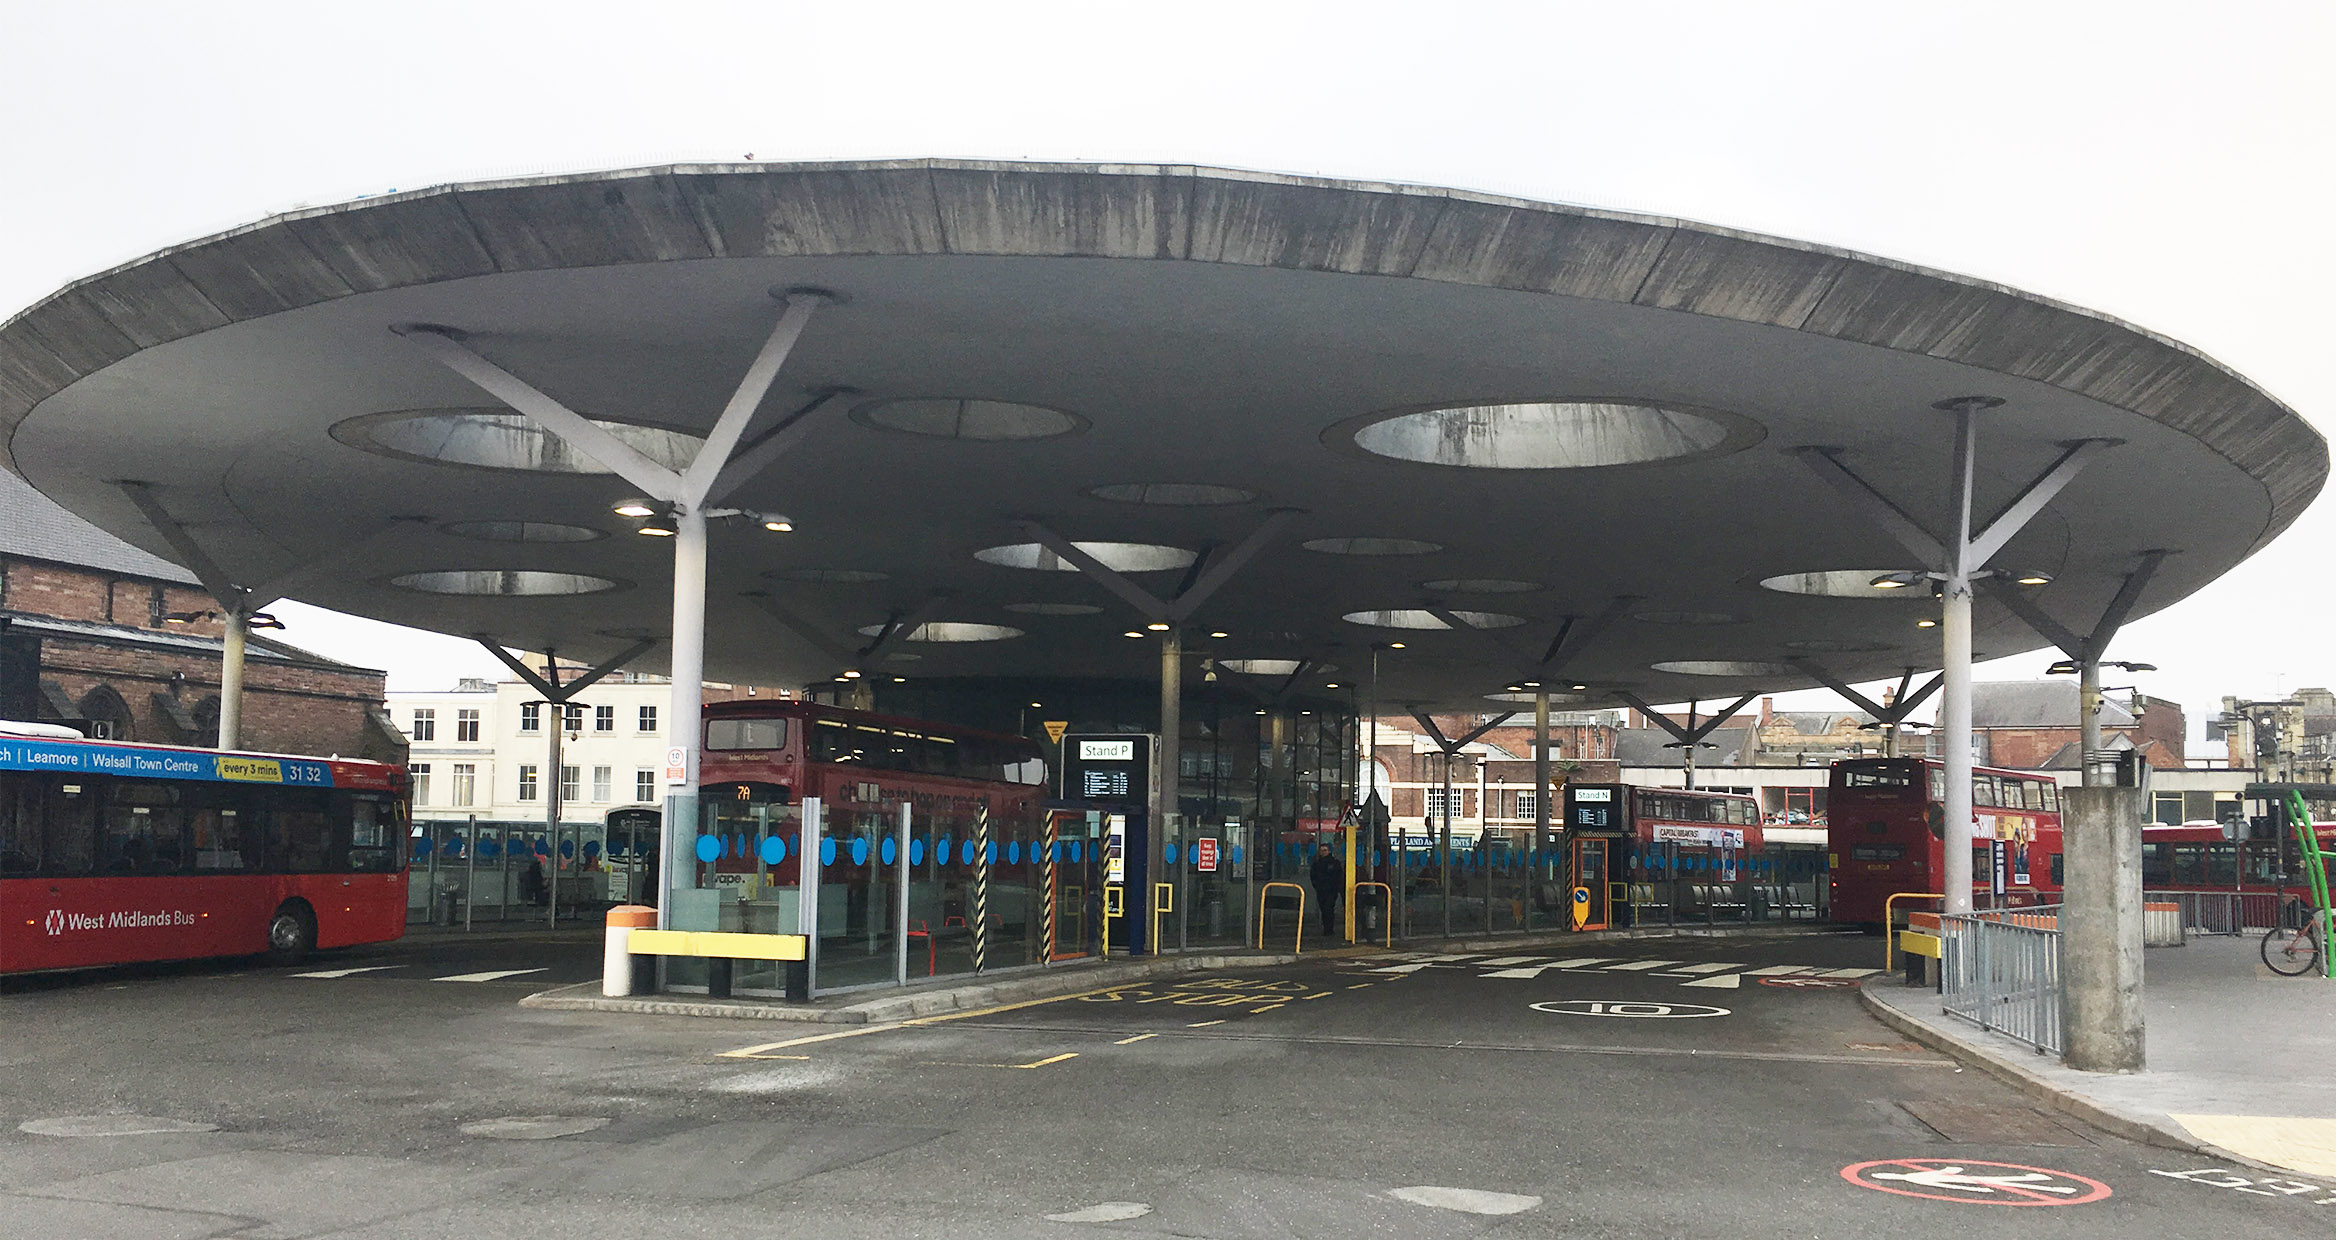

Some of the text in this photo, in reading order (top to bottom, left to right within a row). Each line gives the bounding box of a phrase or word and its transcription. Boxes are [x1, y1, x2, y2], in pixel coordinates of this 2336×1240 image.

[1085, 745, 1128, 756] Stand P
[27, 749, 78, 765] Leamore
[92, 753, 132, 769] Walsall
[134, 756, 161, 770] Town
[164, 758, 199, 773] Centre
[224, 764, 278, 776] every 3 mins
[289, 766, 321, 782] 31 32
[737, 785, 750, 800] 7A
[1577, 791, 1608, 799] Stand N
[68, 910, 195, 930] West Midlands Bus
[1078, 991, 1294, 1007] STOP
[1590, 1003, 1672, 1015] 10
